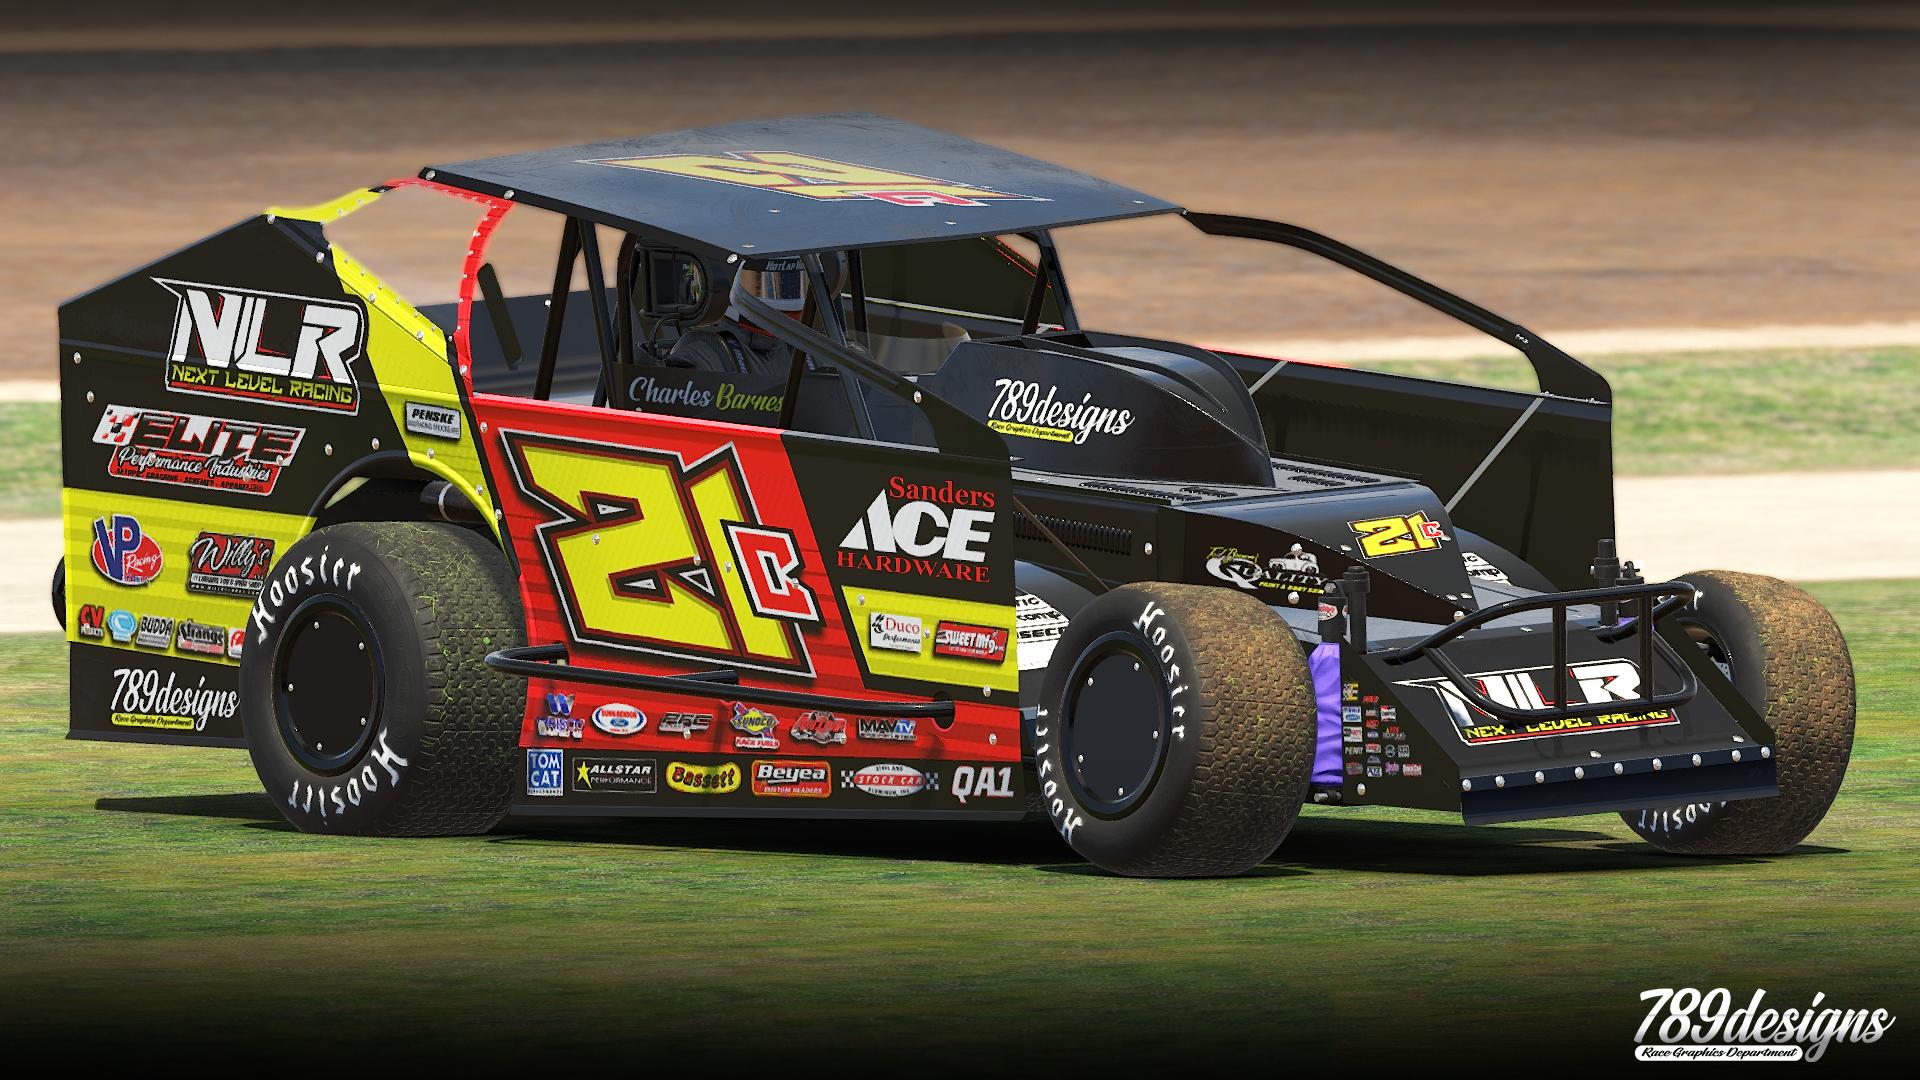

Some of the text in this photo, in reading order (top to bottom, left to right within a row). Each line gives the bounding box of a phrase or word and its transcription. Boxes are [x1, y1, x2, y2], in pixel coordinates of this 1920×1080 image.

[171, 288, 360, 384] NLR
[171, 364, 353, 404] NEXT LEVEL RACING
[629, 376, 784, 412] Charles Barnes
[411, 408, 455, 425] PENSKE
[988, 378, 1135, 445] 789designs
[129, 411, 302, 463] ELITE
[118, 446, 271, 482] Performance Industries
[889, 475, 996, 508] Sanders
[838, 489, 996, 563] ACE
[94, 514, 142, 581] VP
[126, 553, 161, 576] Racing
[192, 537, 270, 577] Willy's
[836, 550, 991, 584] HARDWARE
[252, 544, 362, 645] Hoosier
[80, 604, 105, 629] CV
[140, 615, 174, 637] BUDDA
[885, 617, 920, 635] Duco
[944, 629, 976, 647] SWEET
[1132, 601, 1189, 740] Hoosier
[110, 668, 240, 732] 789designs
[733, 716, 777, 727] SUNOCO
[1464, 724, 1515, 739] NEX
[1526, 718, 1592, 733] LEVEL
[287, 727, 408, 827] Hoosier
[530, 753, 560, 769] TOM
[590, 764, 652, 775] ALLSTAR
[757, 764, 826, 784] Beyea
[1035, 704, 1084, 845] Hoosier
[530, 770, 560, 787] CAT
[590, 776, 652, 785] PERFORMANCE
[672, 767, 735, 790] Bassett
[858, 775, 923, 785] STOCK CAR
[951, 765, 1014, 804] QA1
[1637, 800, 1728, 839] oosier
